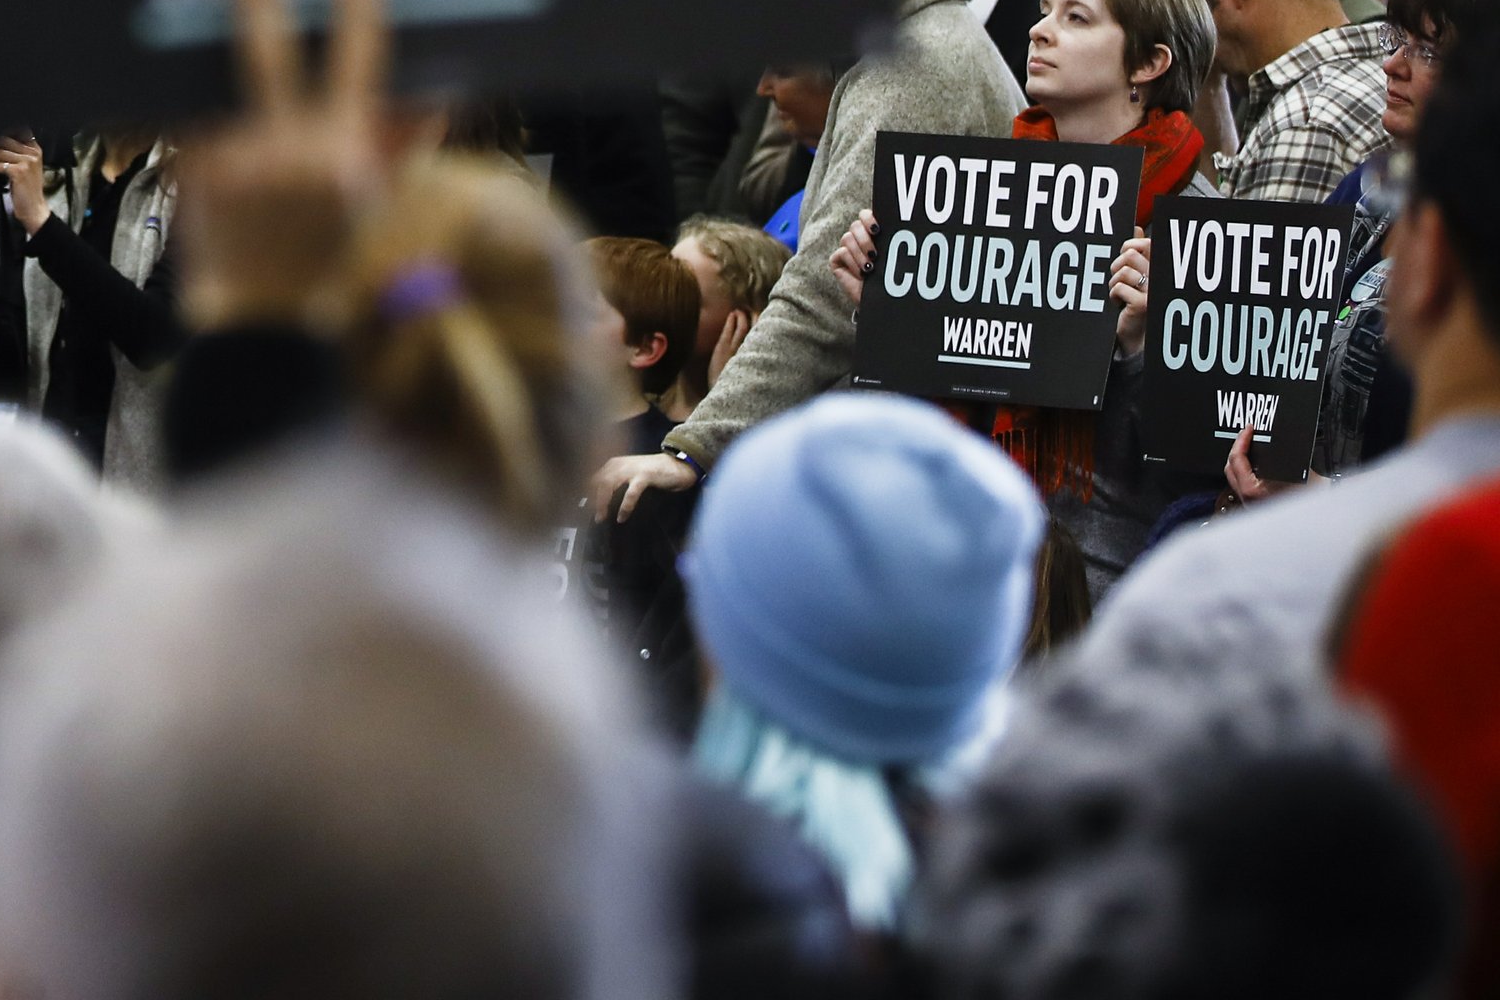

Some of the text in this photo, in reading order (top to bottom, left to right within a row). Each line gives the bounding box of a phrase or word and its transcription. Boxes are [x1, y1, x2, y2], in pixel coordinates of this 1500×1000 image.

[893, 153, 1119, 236] VOTE FOR
[883, 228, 1112, 313] COURAGE
[1169, 218, 1342, 301] VOTE FOR
[942, 315, 1033, 359] WARREN
[1162, 297, 1330, 382] COURAGE
[1216, 389, 1280, 432] WARREN
